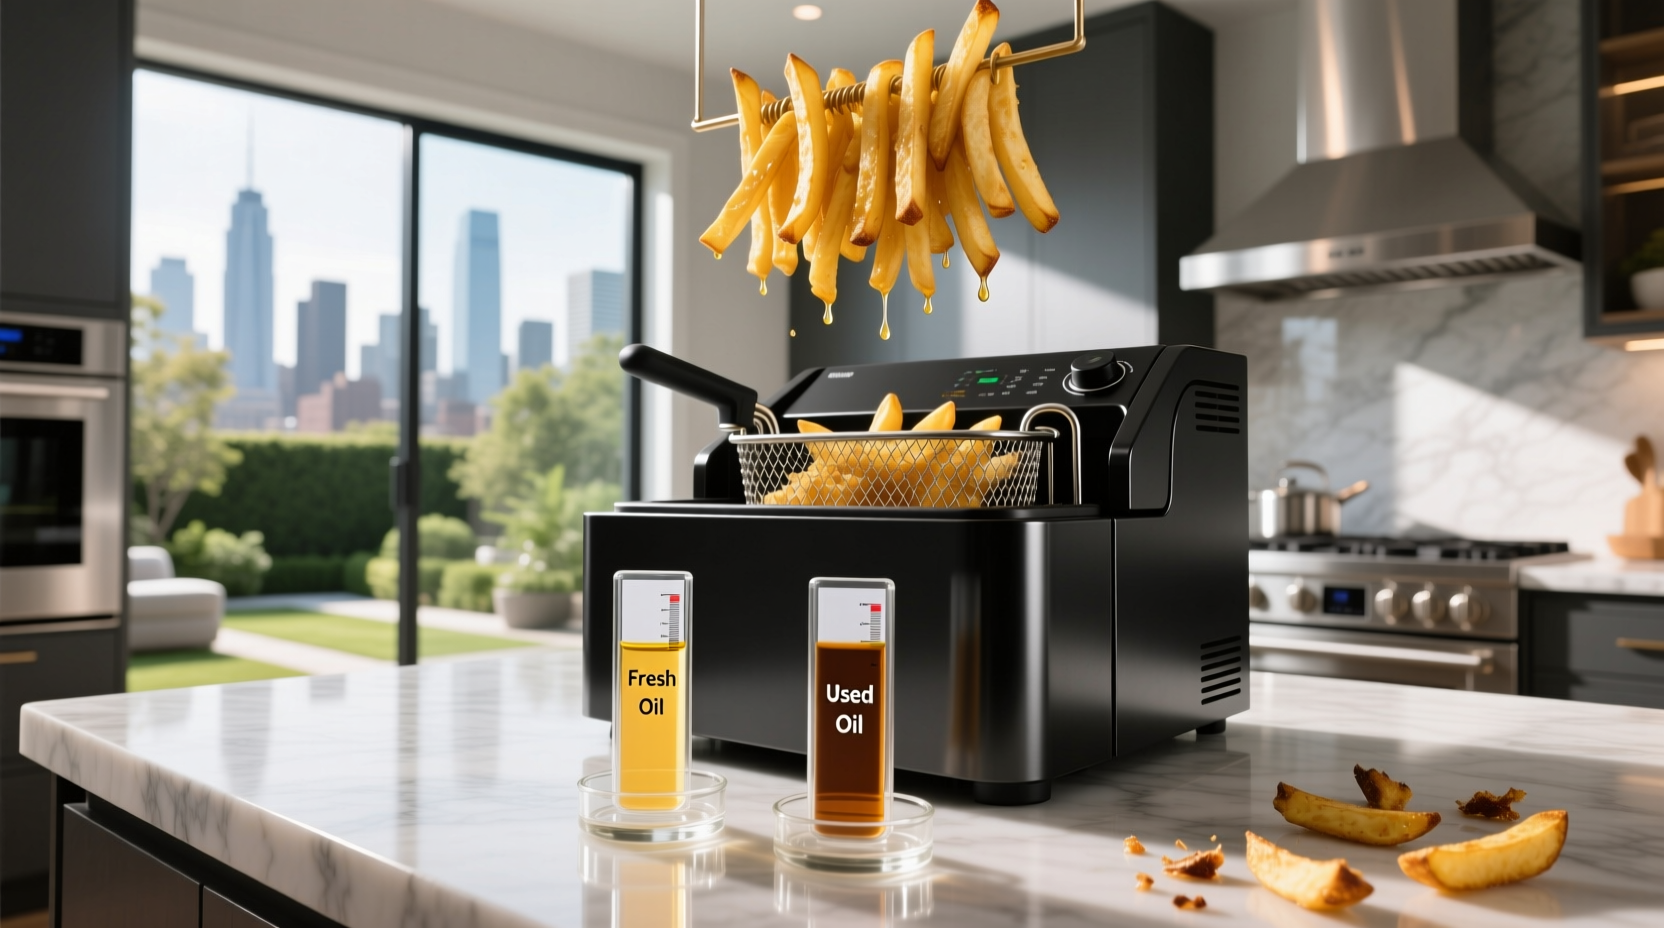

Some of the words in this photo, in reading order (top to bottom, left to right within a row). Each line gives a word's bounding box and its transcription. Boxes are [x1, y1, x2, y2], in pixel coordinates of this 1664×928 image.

[628, 669, 676, 687] Fresh
[826, 684, 874, 704] Used
[639, 698, 664, 715] Oil
[836, 714, 863, 734] Oil
